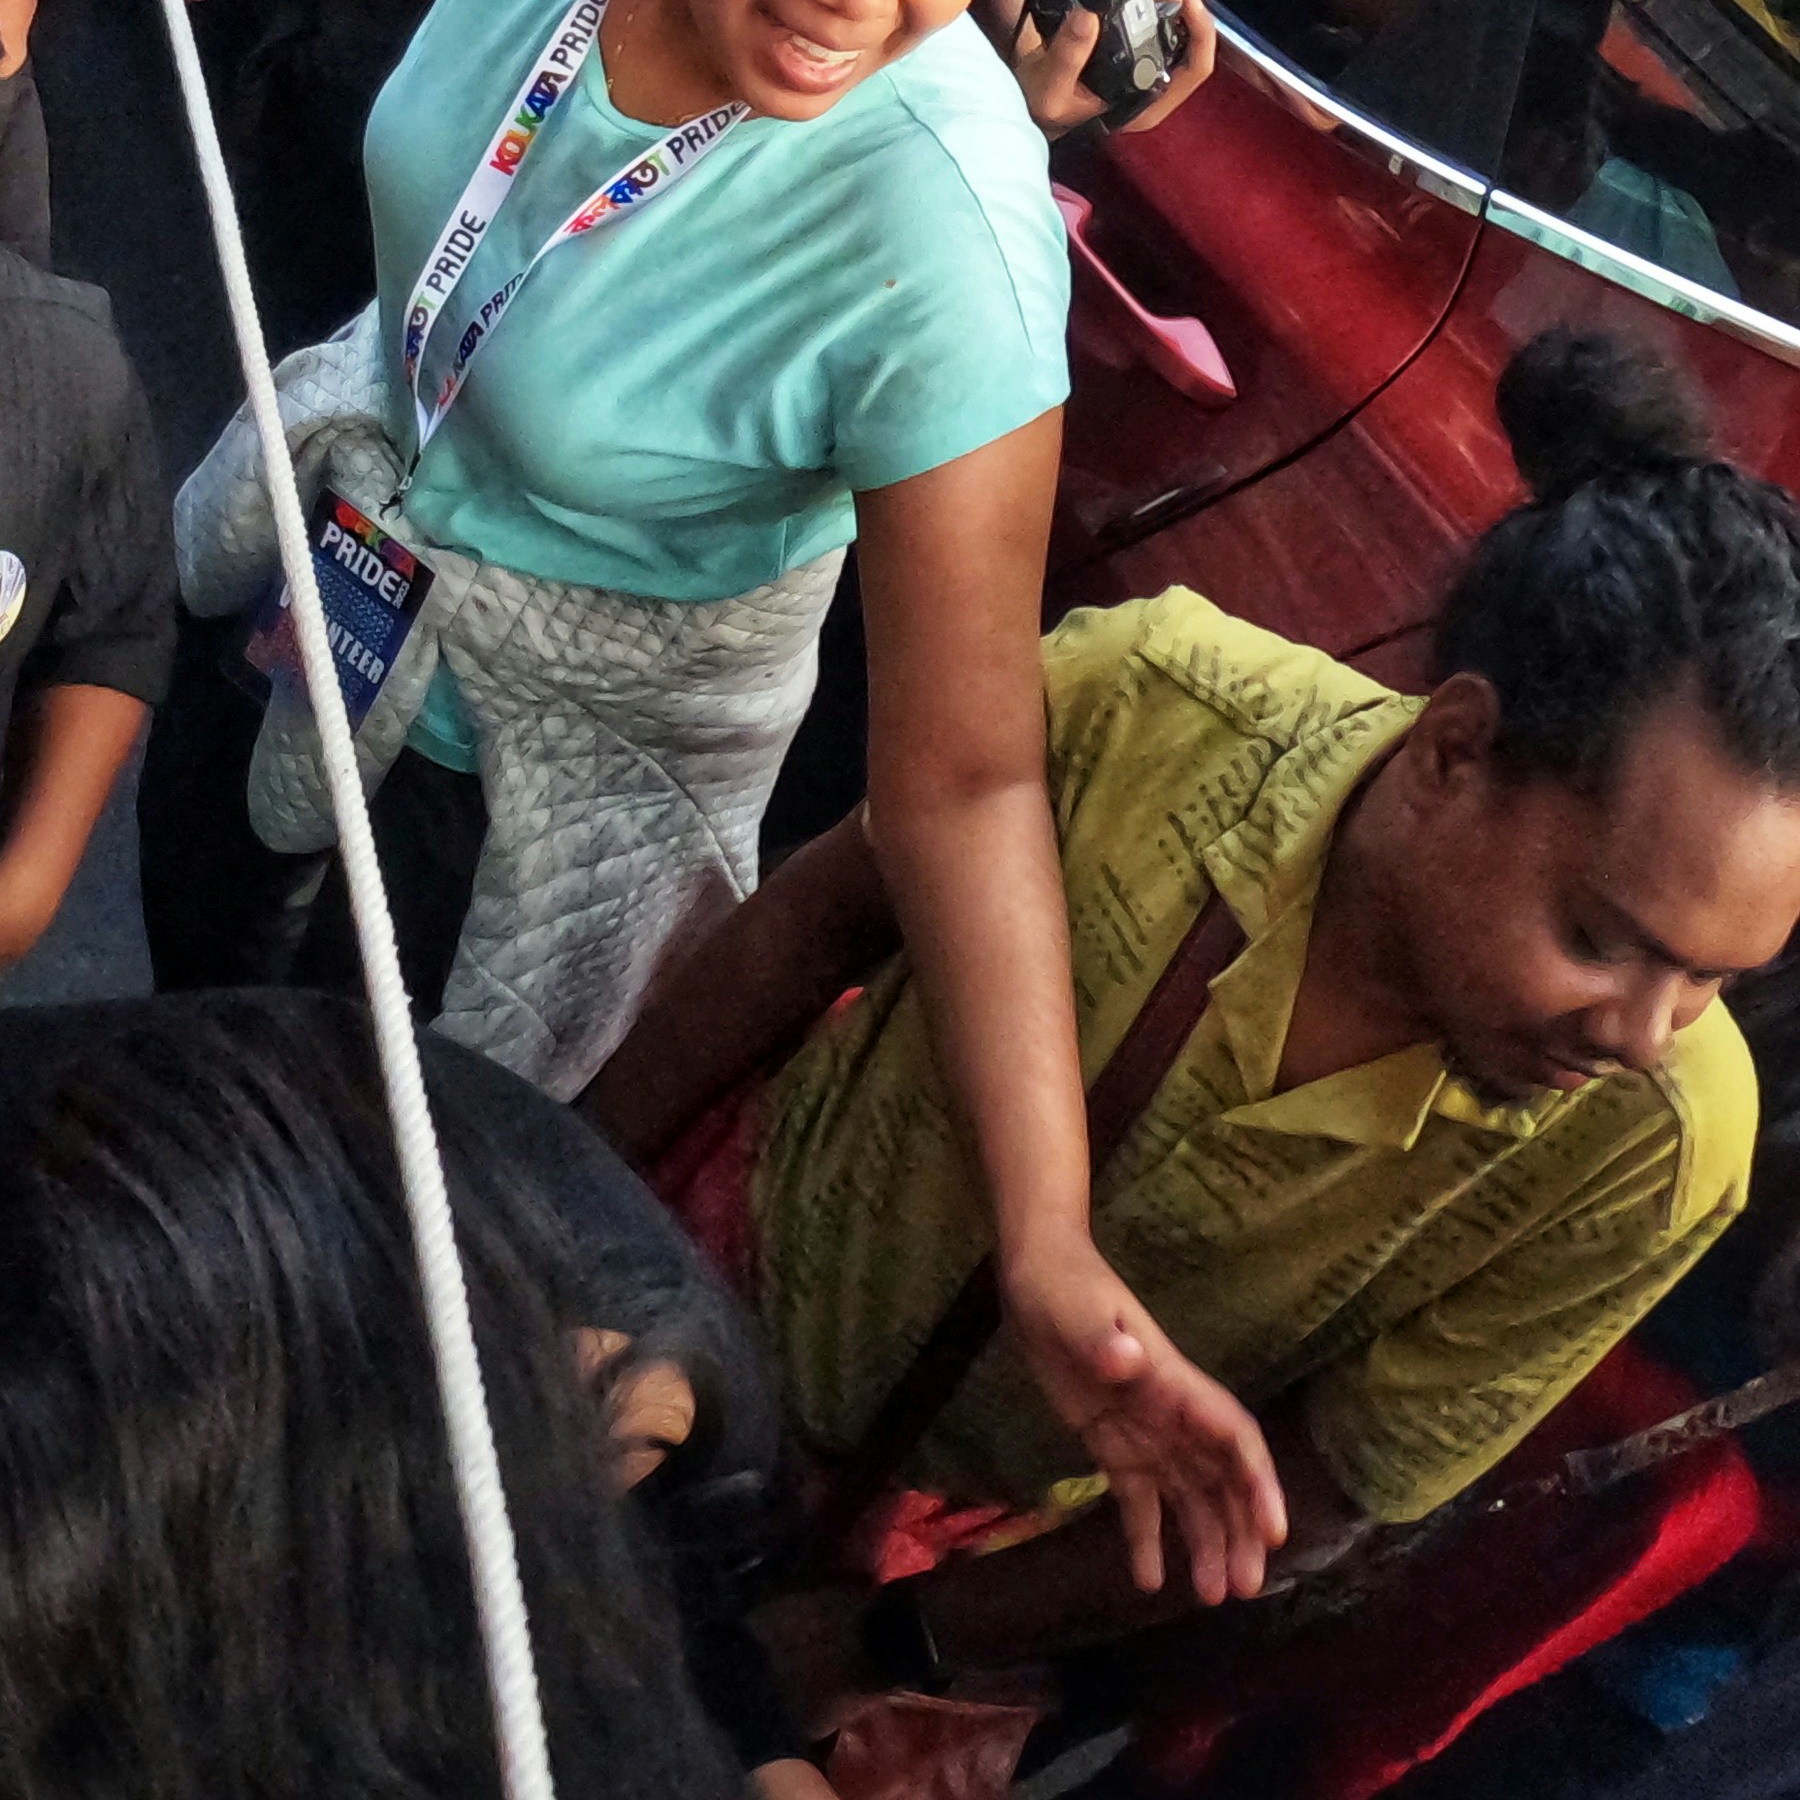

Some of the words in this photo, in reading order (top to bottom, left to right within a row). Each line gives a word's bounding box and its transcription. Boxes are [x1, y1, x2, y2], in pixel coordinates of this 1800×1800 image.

[489, 71, 568, 176] KOLKATA
[666, 99, 748, 165] PRIDE
[426, 209, 487, 295] PRIDE
[320, 520, 401, 604] PRIDE
